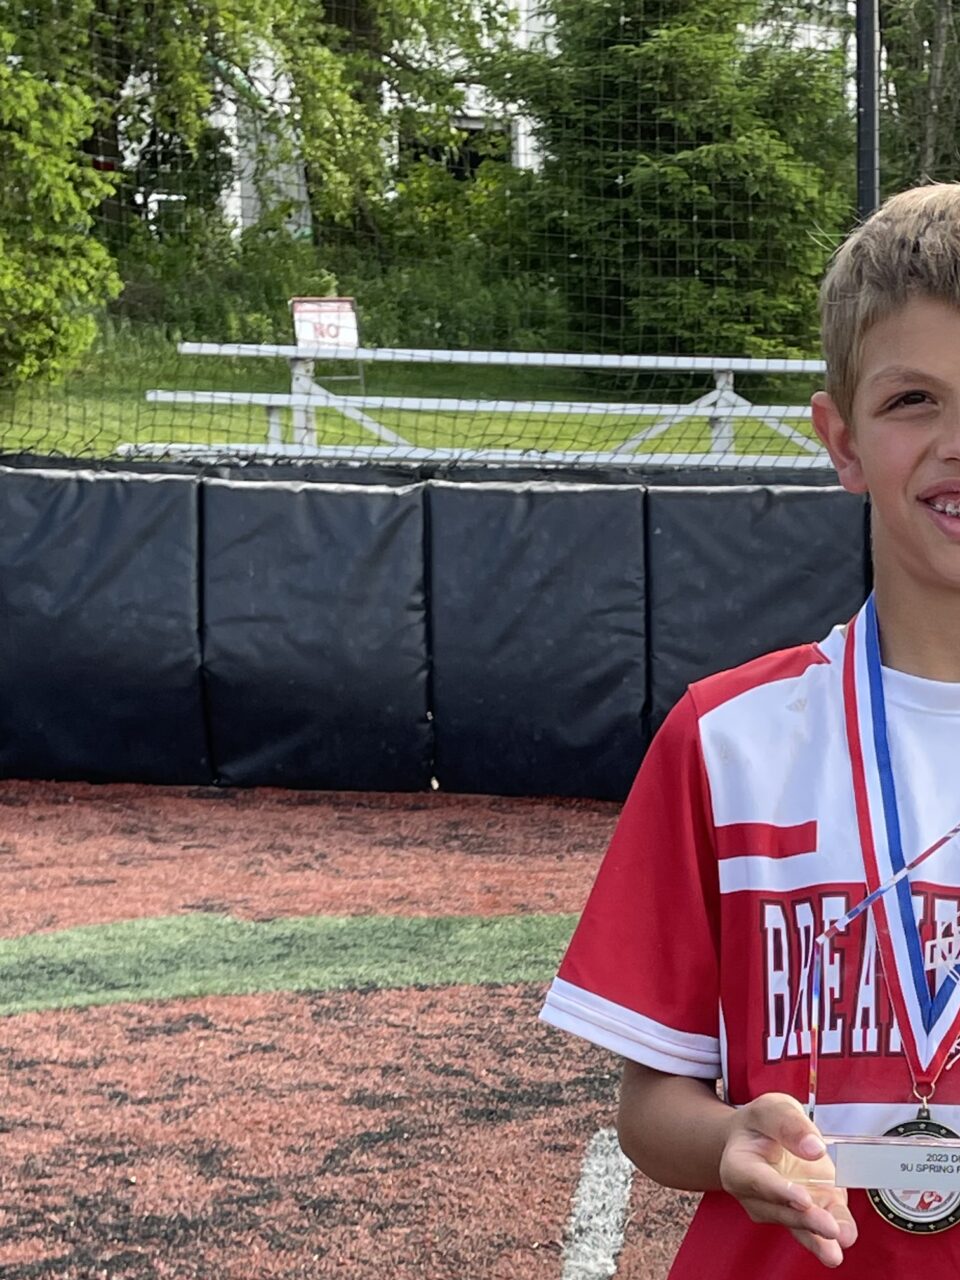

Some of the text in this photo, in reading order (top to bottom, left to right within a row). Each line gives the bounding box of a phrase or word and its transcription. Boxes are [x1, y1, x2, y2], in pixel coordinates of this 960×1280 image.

[926, 1153, 949, 1162] 2023
[900, 1163, 914, 1172] 9U
[915, 1164, 954, 1174] SPRING
